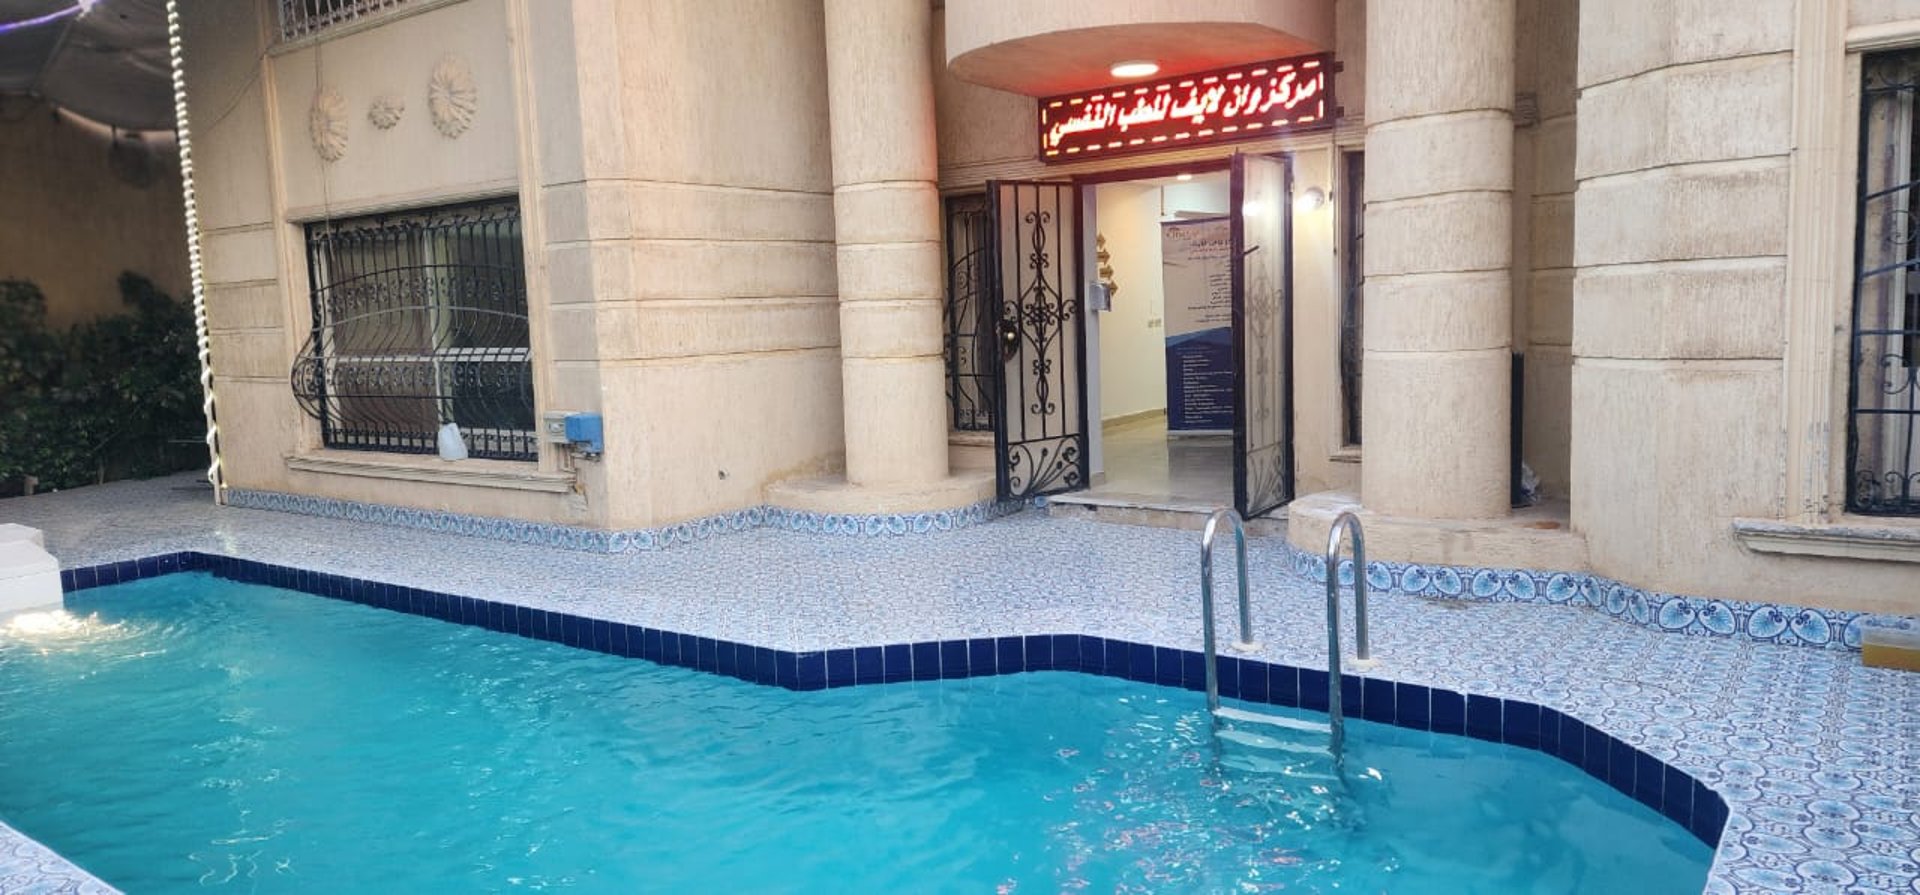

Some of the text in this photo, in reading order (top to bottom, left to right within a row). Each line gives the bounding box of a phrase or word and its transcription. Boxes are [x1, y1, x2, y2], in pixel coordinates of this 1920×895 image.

[1049, 72, 1317, 146] مركز وان لايف للطب النفسي
